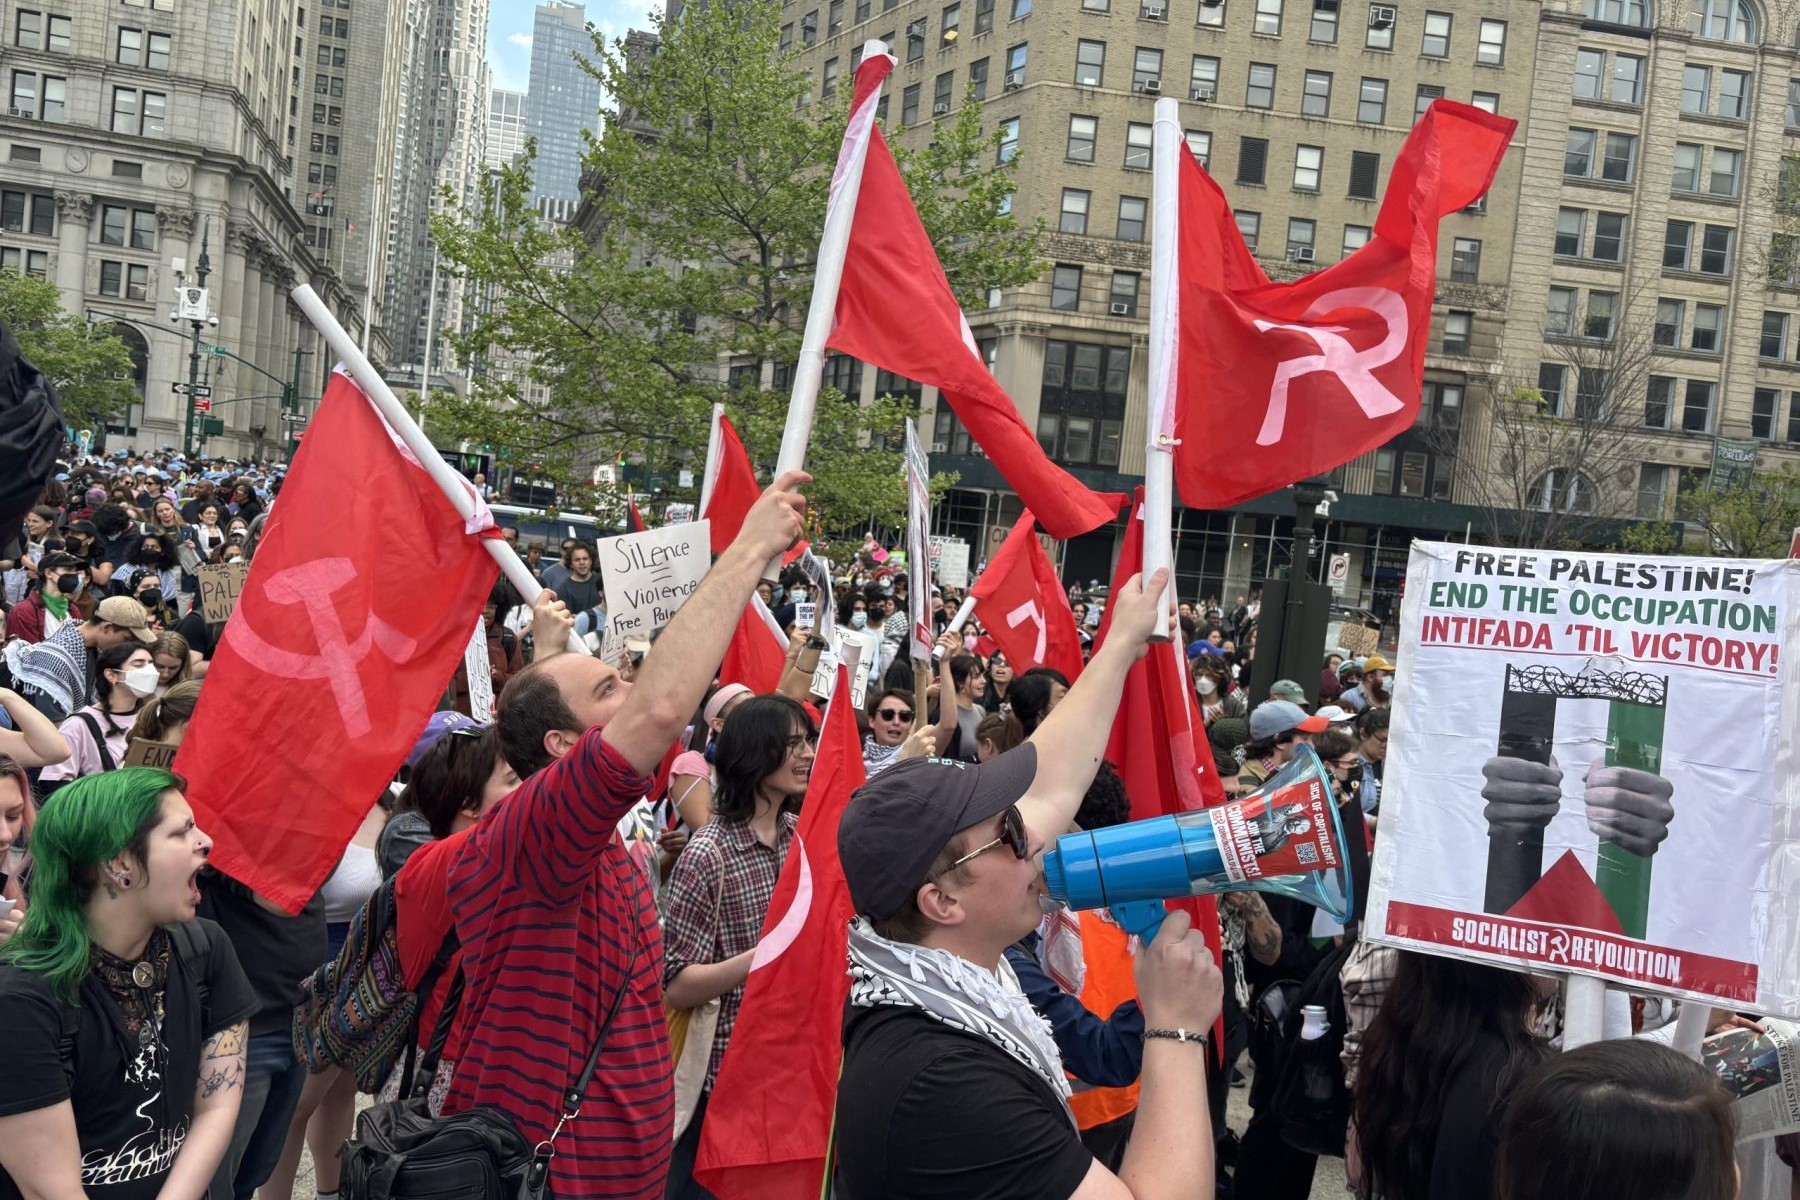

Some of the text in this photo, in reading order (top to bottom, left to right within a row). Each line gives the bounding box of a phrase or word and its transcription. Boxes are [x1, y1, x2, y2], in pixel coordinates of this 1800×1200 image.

[1735, 452, 1755, 461] LEAS
[624, 580, 697, 609] Violence
[1455, 551, 1756, 595] FREE PALESTINE!
[613, 612, 642, 635] Free
[1429, 581, 1777, 633] END THE OCCUPATION
[1421, 615, 1553, 650] INTIFADA
[1631, 631, 1779, 674] VICTORY!
[1227, 804, 1262, 878] COMMUNISTS!
[1246, 820, 1265, 854] JOIN THE
[1310, 781, 1336, 865] SICK OF CAPITALISM?
[1452, 917, 1681, 982] SOCIALIST REVOLUTION
[1780, 1053, 1790, 1071] FOR
